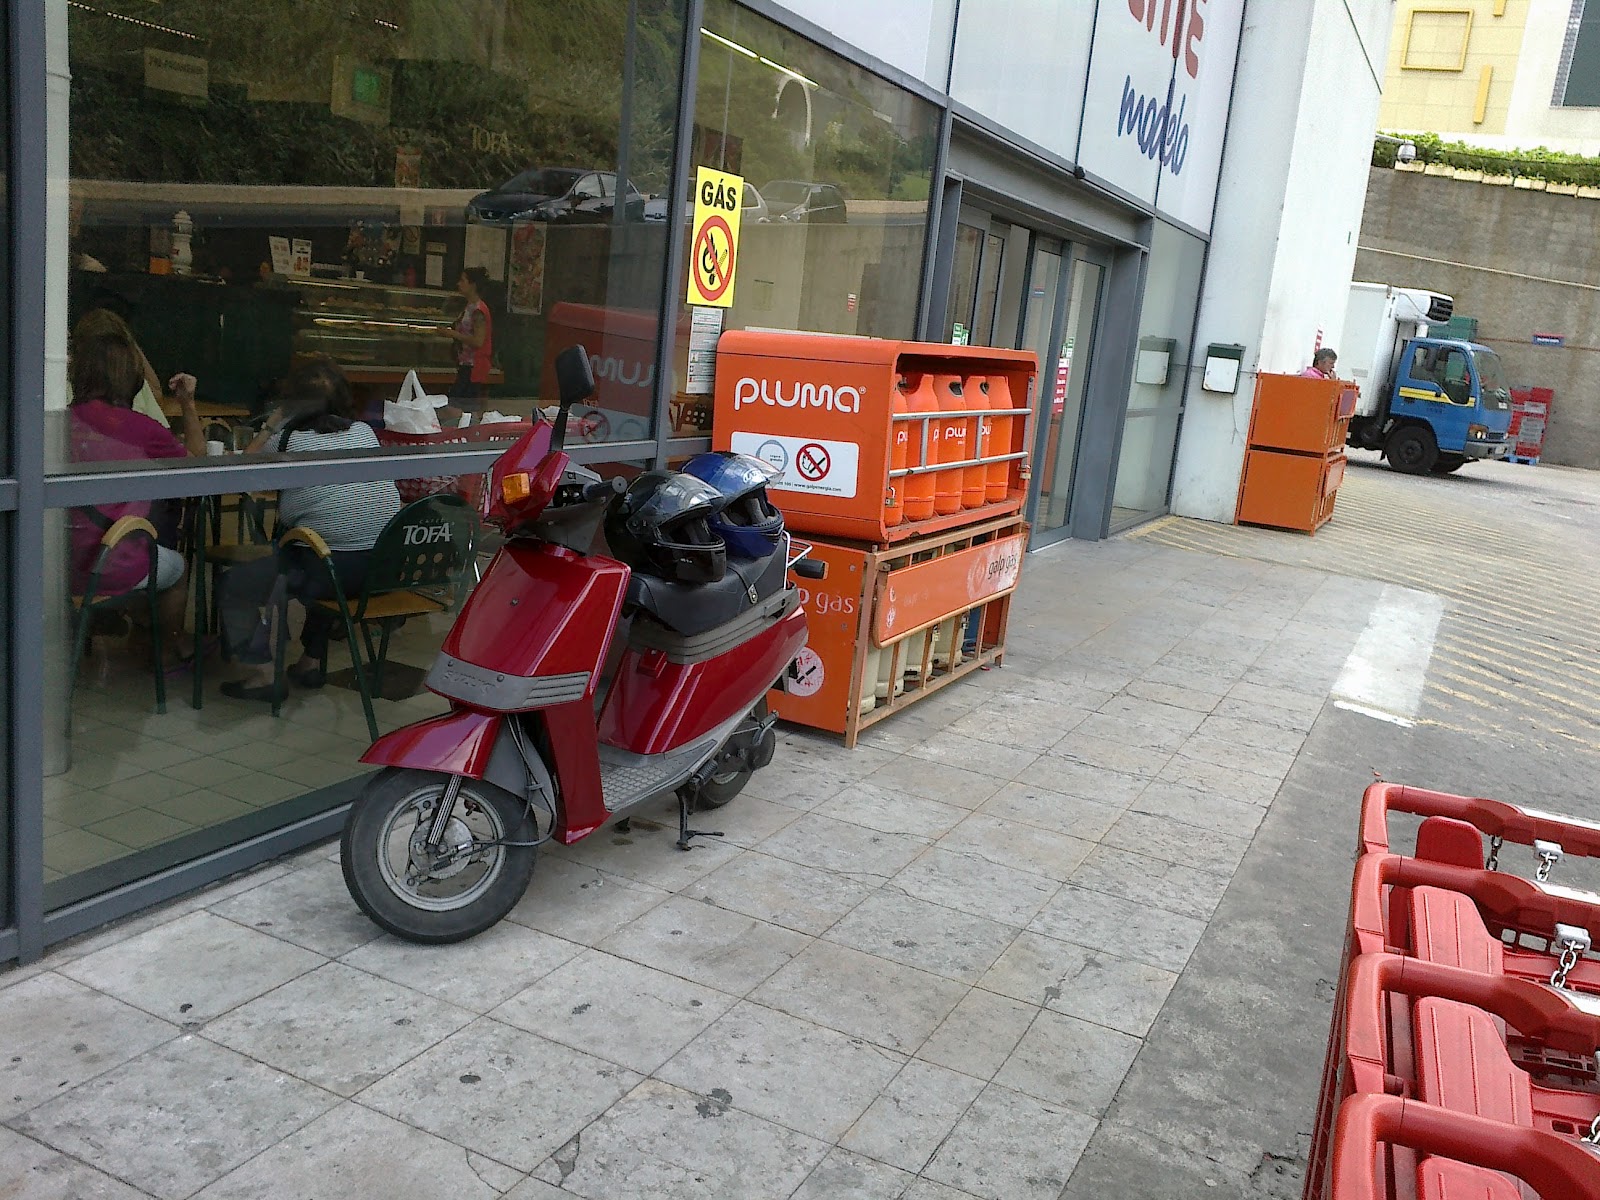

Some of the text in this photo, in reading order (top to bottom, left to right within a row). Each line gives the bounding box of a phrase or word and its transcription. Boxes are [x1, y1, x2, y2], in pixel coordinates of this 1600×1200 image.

[1118, 75, 1189, 175] modelo
[701, 178, 737, 212] GÁS
[403, 522, 453, 545] TOFA
[988, 554, 1005, 579] galp
